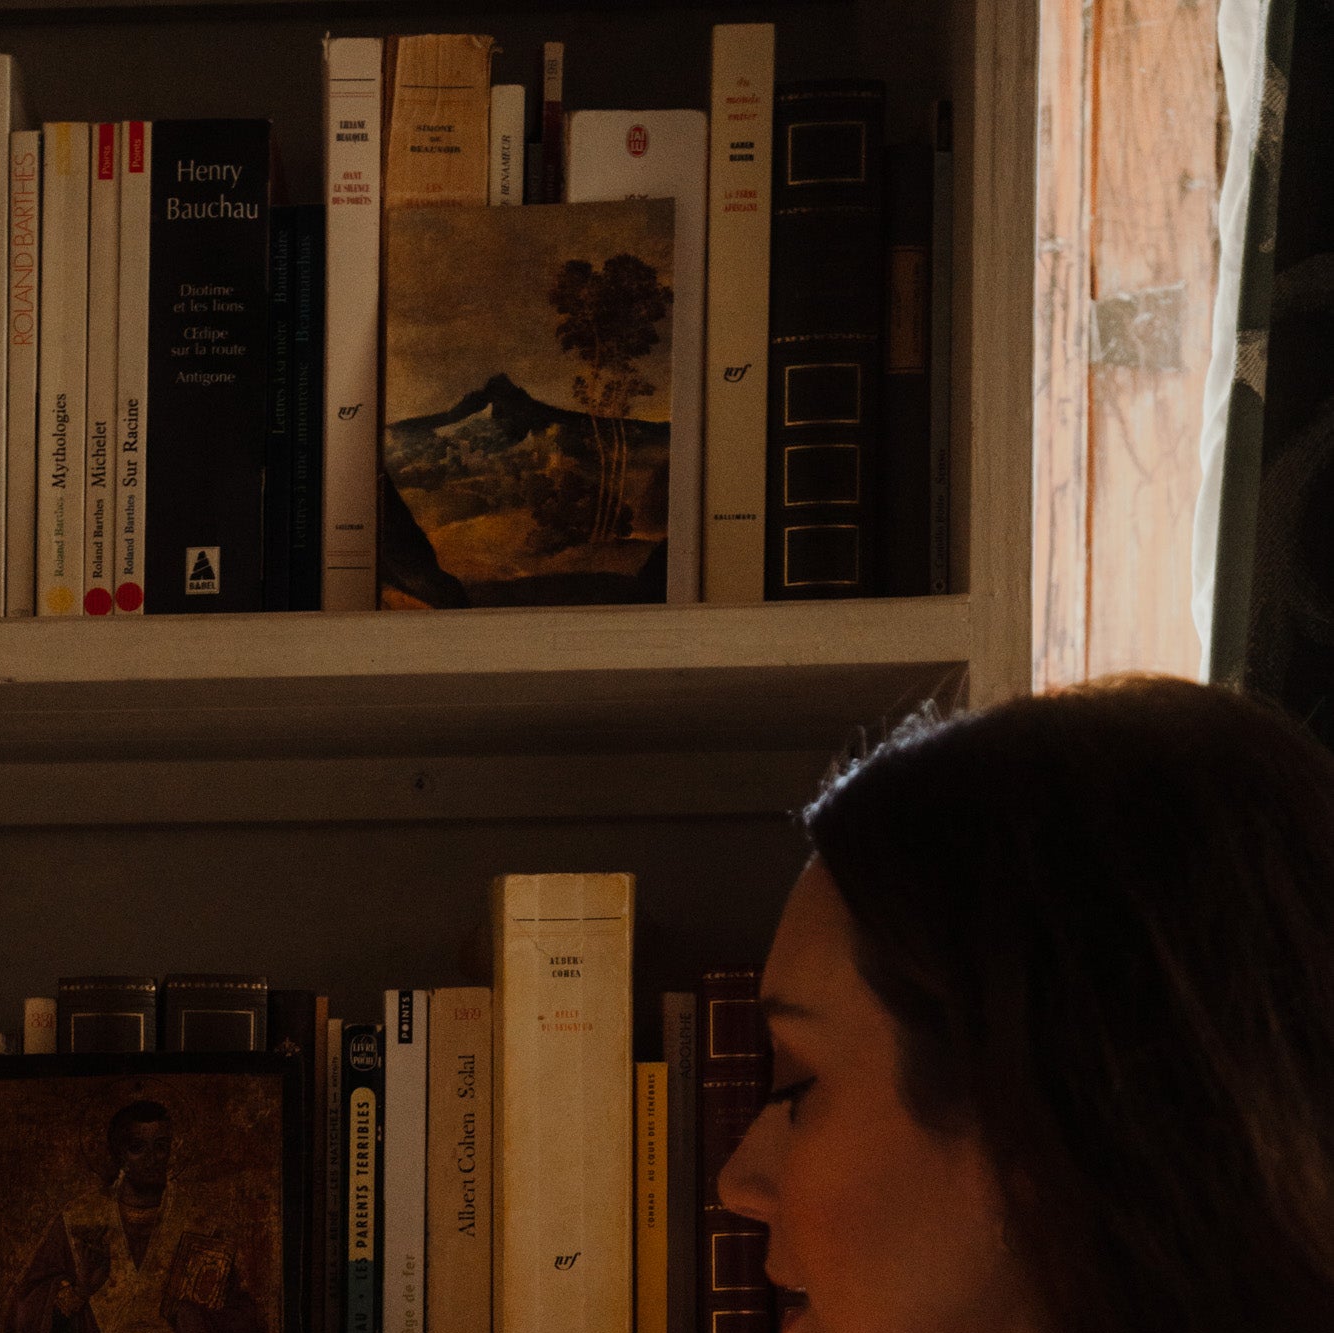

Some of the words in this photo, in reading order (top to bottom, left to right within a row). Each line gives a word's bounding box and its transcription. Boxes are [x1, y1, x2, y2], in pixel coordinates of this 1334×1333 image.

[177, 159, 242, 188] Henry
[14, 152, 35, 246] BARTHES
[167, 194, 259, 220] Bauchau
[13, 252, 34, 346] ROLAND
[51, 393, 68, 489] Mythologies
[123, 399, 138, 453] Racine
[123, 459, 138, 487] Sur
[53, 497, 65, 536] Barthes
[124, 495, 136, 534] Barthes
[53, 540, 65, 577] Roland
[124, 539, 136, 575] Roland
